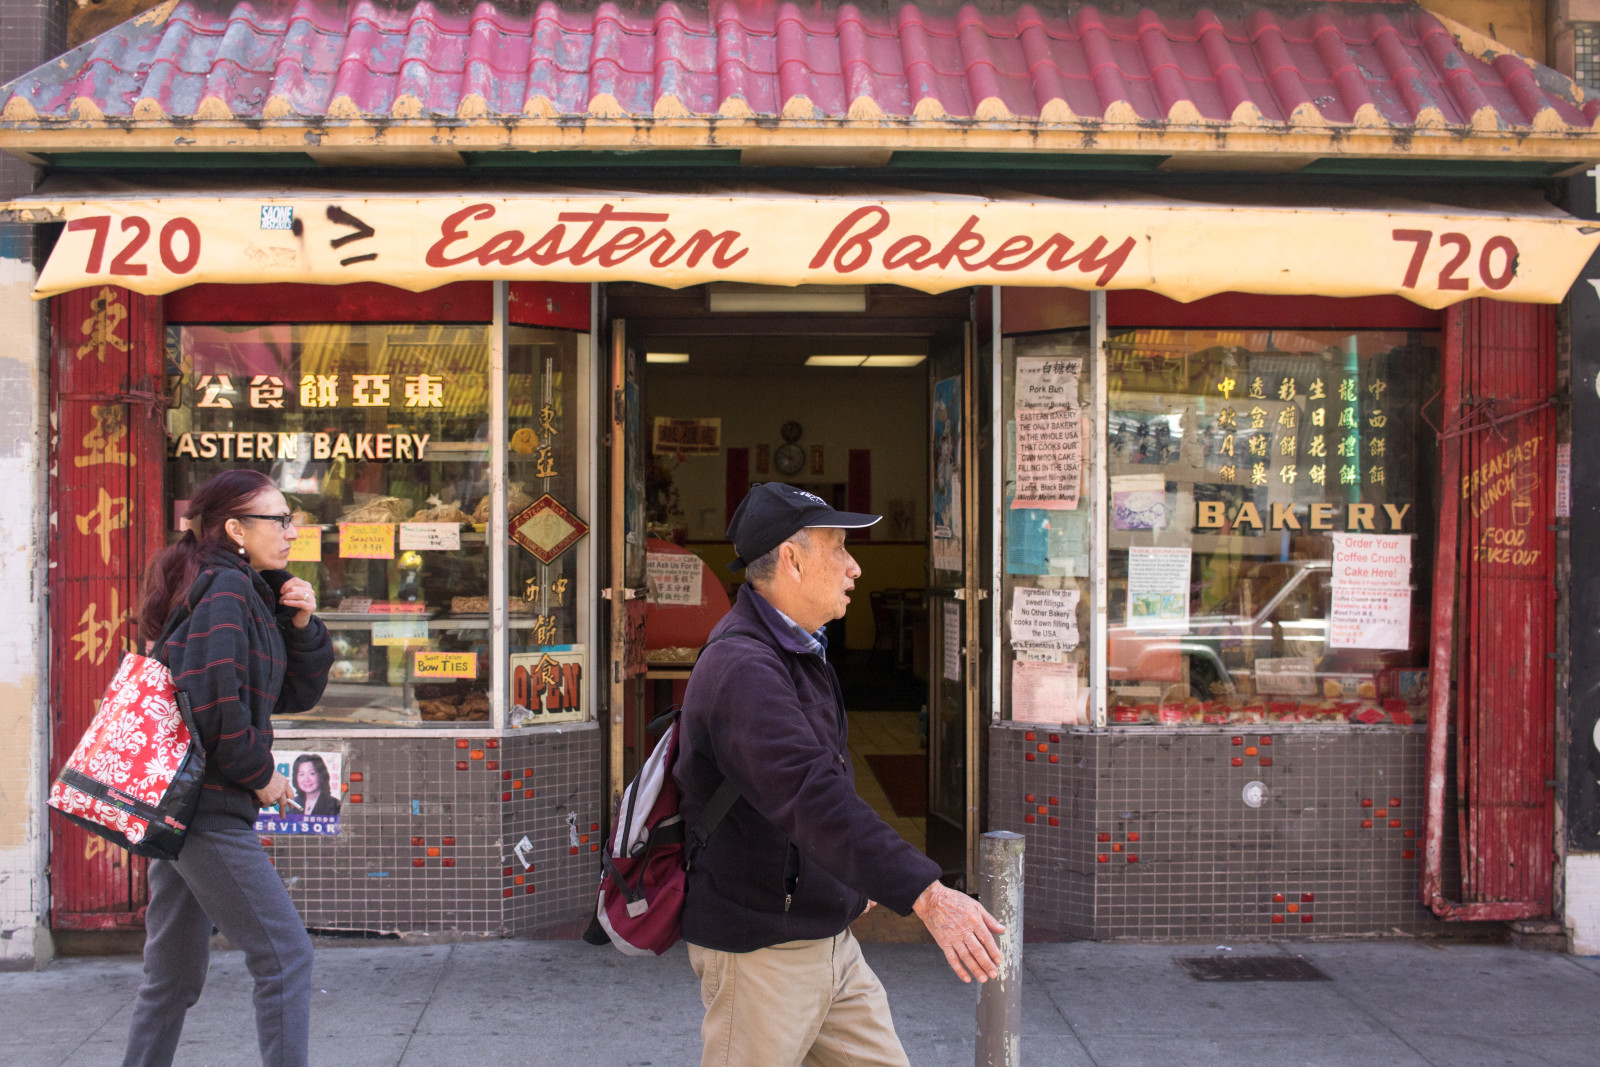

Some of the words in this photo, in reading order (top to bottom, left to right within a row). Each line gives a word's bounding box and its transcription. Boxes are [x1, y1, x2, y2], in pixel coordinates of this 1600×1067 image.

[67, 215, 201, 276] 720
[425, 203, 749, 269] Eastern
[808, 205, 1137, 286] Bakery
[1392, 229, 1519, 291] 720
[1029, 385, 1046, 393] Pork
[1048, 385, 1064, 393] Bun
[1020, 413, 1049, 421] EASTERN
[1050, 411, 1077, 419] BAKERY
[1020, 423, 1031, 431] THE
[1033, 422, 1050, 430] ONLY
[1051, 421, 1078, 429] BAKERY
[175, 432, 298, 460] ASTERN
[313, 433, 431, 460] BAKERY
[1062, 442, 1077, 450] OUR
[1037, 453, 1057, 461] MOON
[1018, 464, 1041, 472] FILLING
[1462, 436, 1543, 499] BREAKFAST
[1471, 471, 1516, 518] LUNCH
[1198, 501, 1411, 530] BAKERY
[1345, 537, 1374, 548] Order
[1375, 538, 1399, 549] Your
[1481, 527, 1526, 547] FOOD
[1336, 551, 1368, 562] Coffee
[1370, 552, 1406, 564] Crunch
[1512, 550, 1542, 566] OUT
[1344, 566, 1369, 577] Cake
[1371, 567, 1397, 578] Here!
[1021, 608, 1030, 616] No
[1031, 608, 1047, 617] Other
[1048, 609, 1070, 619] Bakery
[1053, 620, 1070, 629] filling
[513, 662, 581, 713] OPEN
[255, 821, 336, 833] ERVISOR
